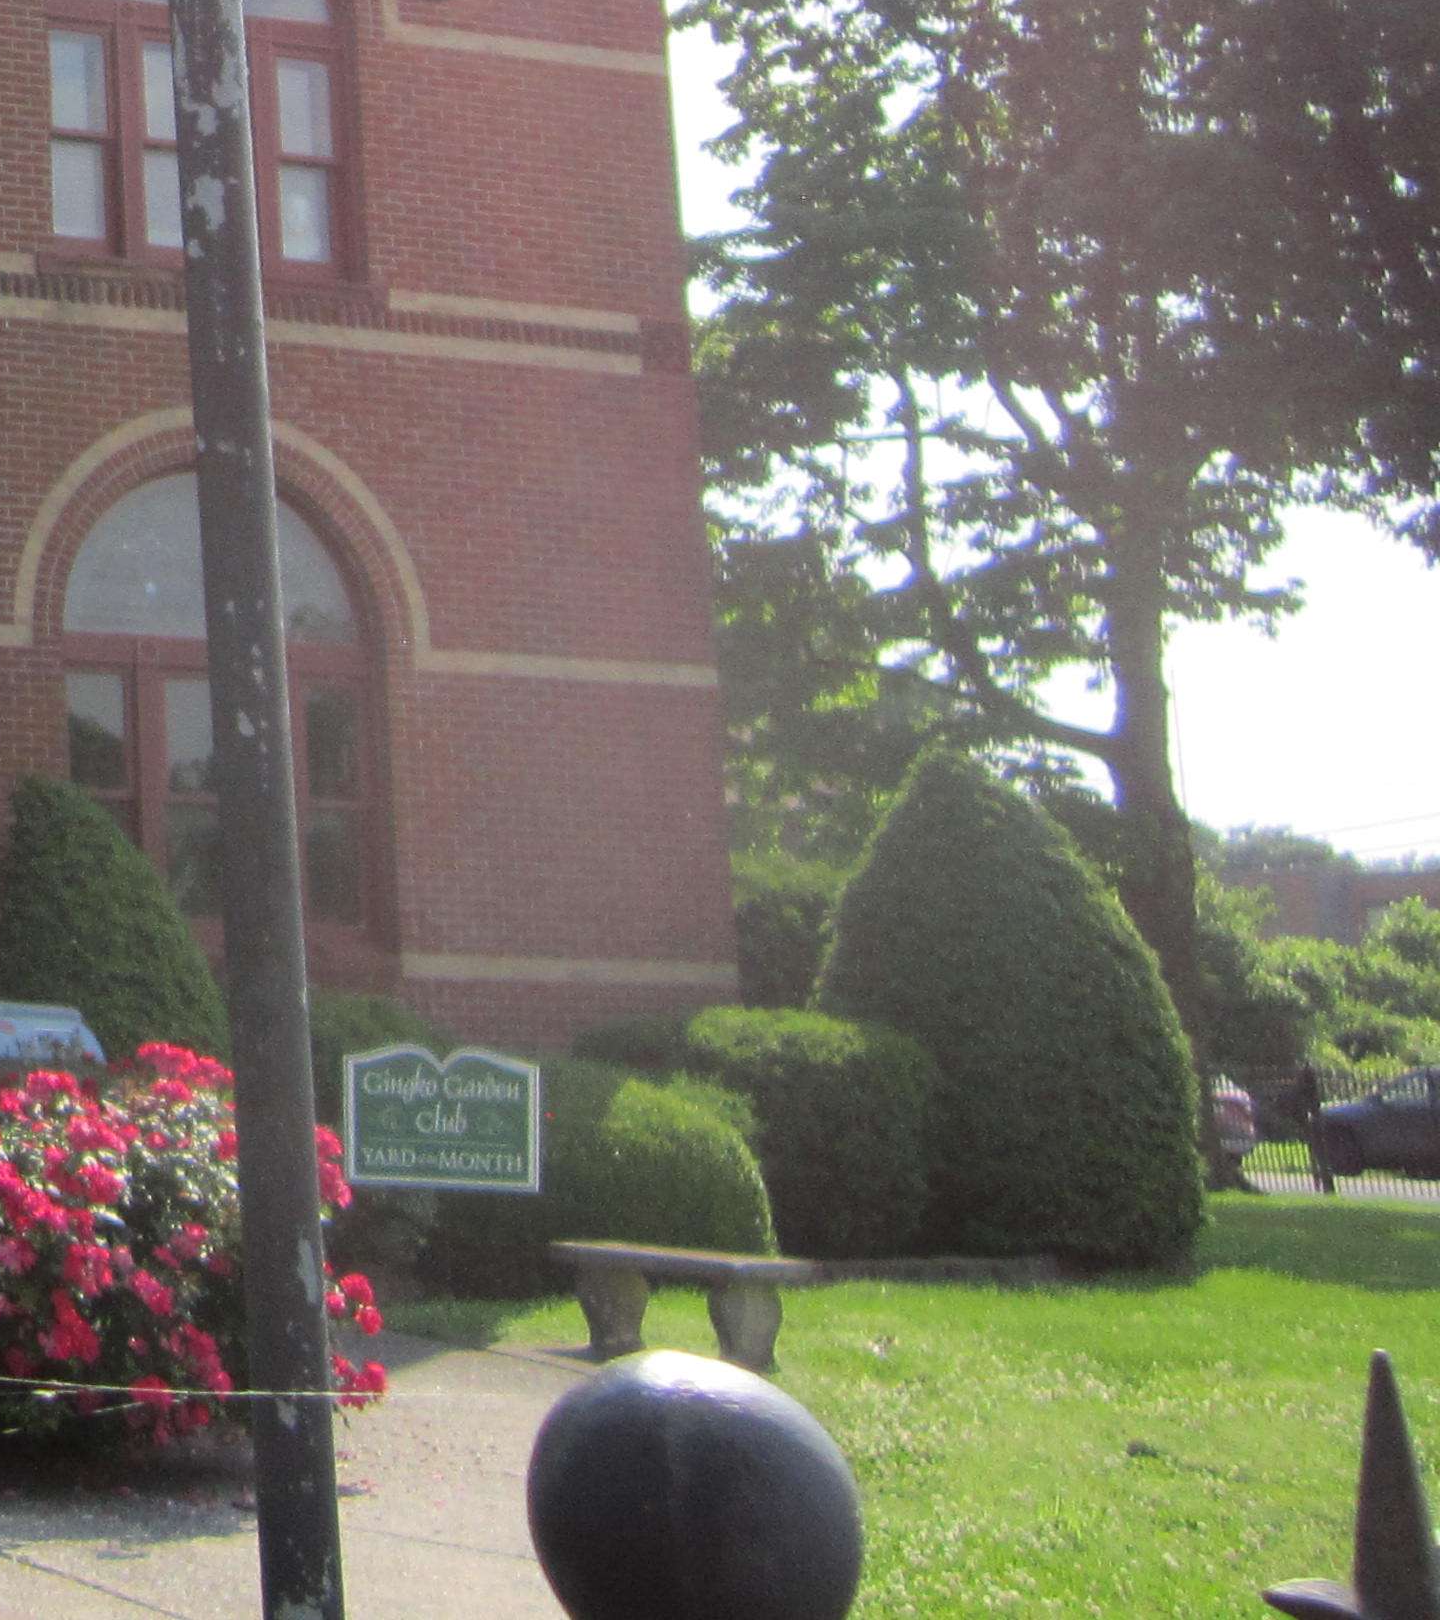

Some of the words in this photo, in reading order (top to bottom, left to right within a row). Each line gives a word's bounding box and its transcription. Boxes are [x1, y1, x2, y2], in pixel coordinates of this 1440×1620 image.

[443, 1074, 521, 1102] Garden
[415, 1101, 468, 1134] Club
[361, 1147, 416, 1168] YARD
[438, 1150, 523, 1173] MONTH
